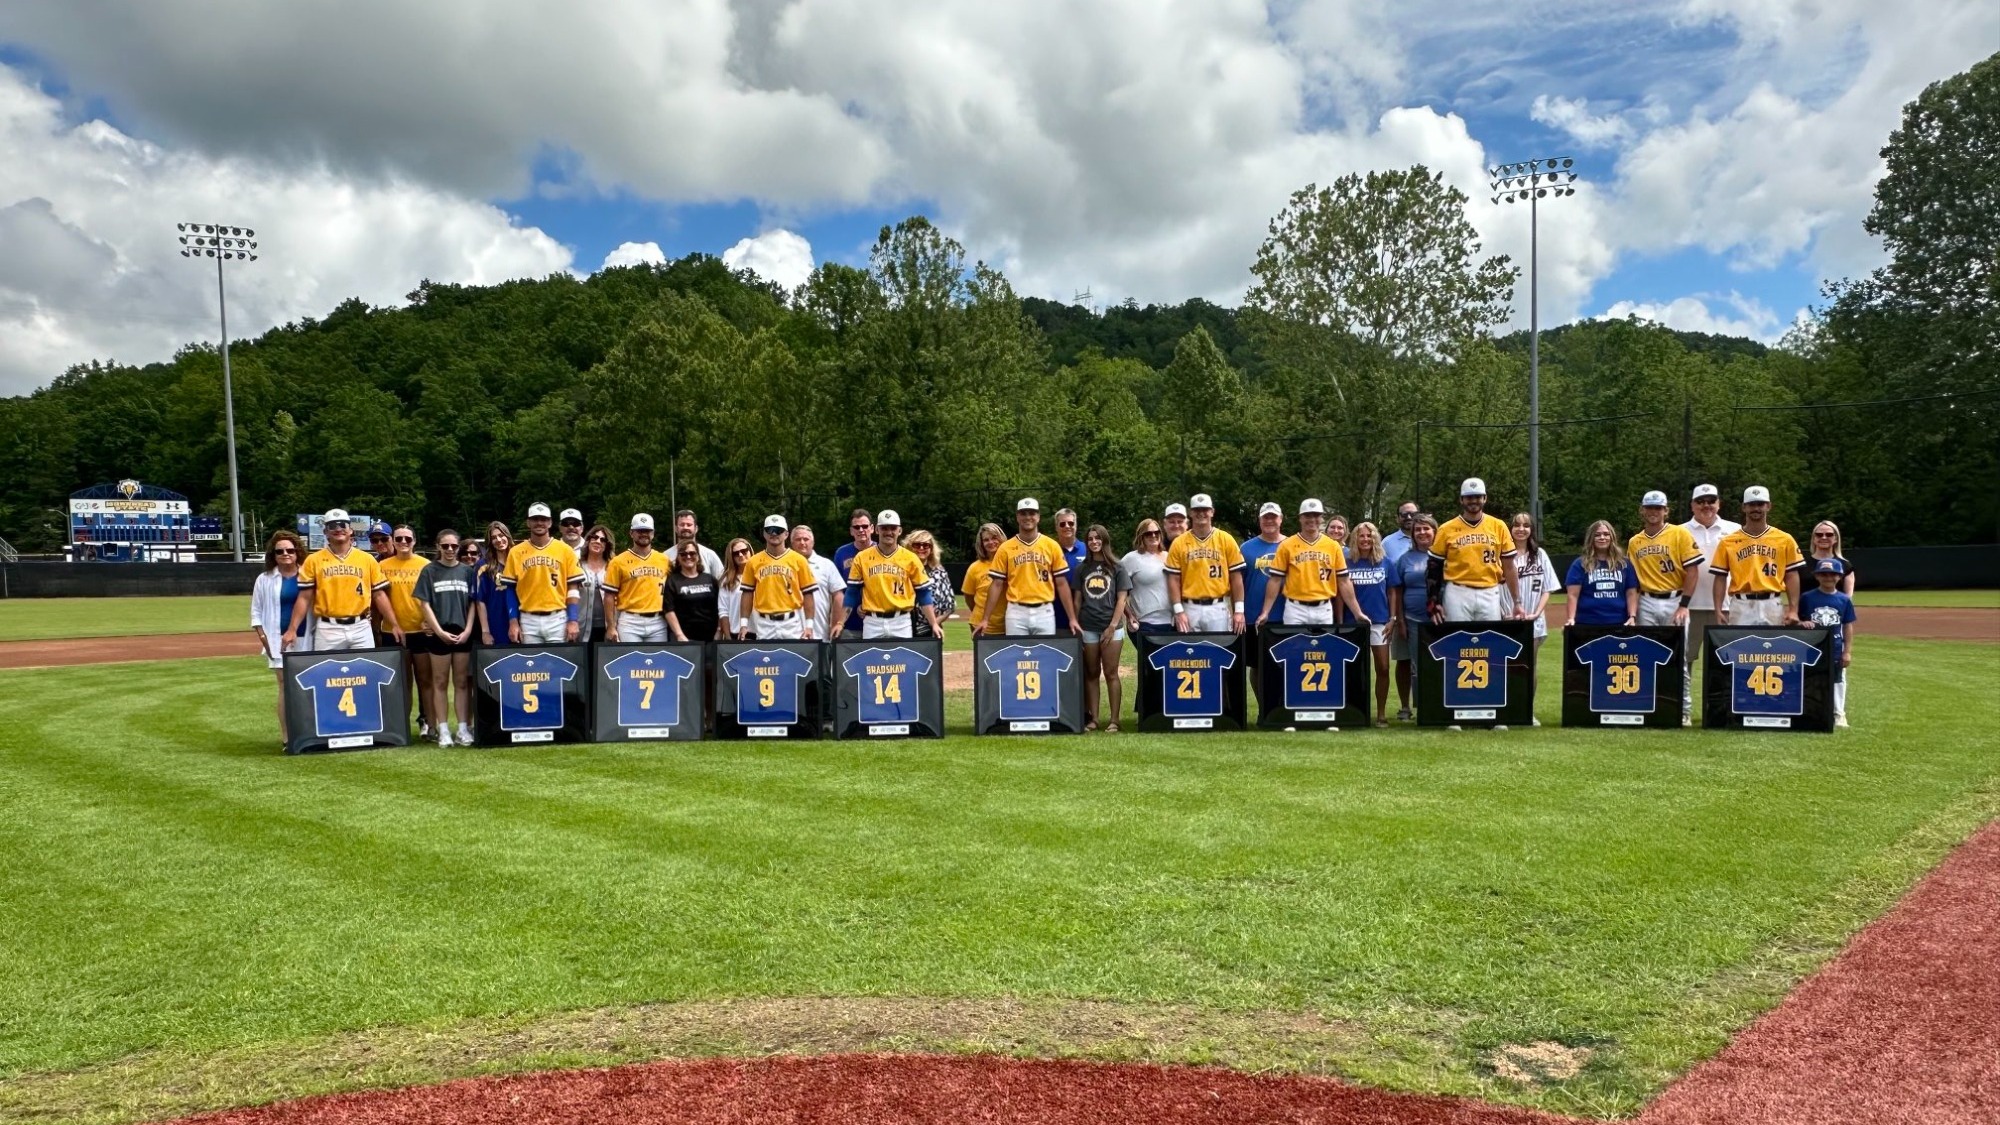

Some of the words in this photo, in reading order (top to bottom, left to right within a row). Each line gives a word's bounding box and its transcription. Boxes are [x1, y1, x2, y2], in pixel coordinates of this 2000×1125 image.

[1635, 545, 1670, 559] MOREHEAD
[1735, 544, 1777, 562] MOREHEAD
[322, 564, 363, 579] MOREHEAD
[1209, 564, 1222, 578] 21
[1659, 559, 1675, 573] 30
[1762, 562, 1777, 577] 46
[550, 573, 558, 587] 5
[1319, 568, 1332, 581] 27
[355, 581, 363, 596] 4
[893, 581, 904, 595] 14
[1531, 579, 1541, 592] 2
[1304, 651, 1326, 661] FERRY
[1460, 648, 1489, 658] HERRON
[1608, 654, 1639, 664] THOMAS
[1738, 653, 1796, 664] BLANKENSHIP
[866, 664, 906, 675] BRADSHAW
[1016, 660, 1039, 670] KUNTZ
[1300, 662, 1331, 691] 27
[1457, 659, 1489, 688] 29
[1606, 665, 1640, 695] 30
[1746, 665, 1783, 695] 46
[326, 676, 367, 688] ANDERSON
[873, 674, 901, 705] 14
[1016, 671, 1041, 700] 19
[1177, 670, 1201, 699] 21
[523, 682, 539, 713] 5
[639, 680, 655, 709] 7
[759, 678, 775, 707] 9
[338, 687, 357, 717] 4
